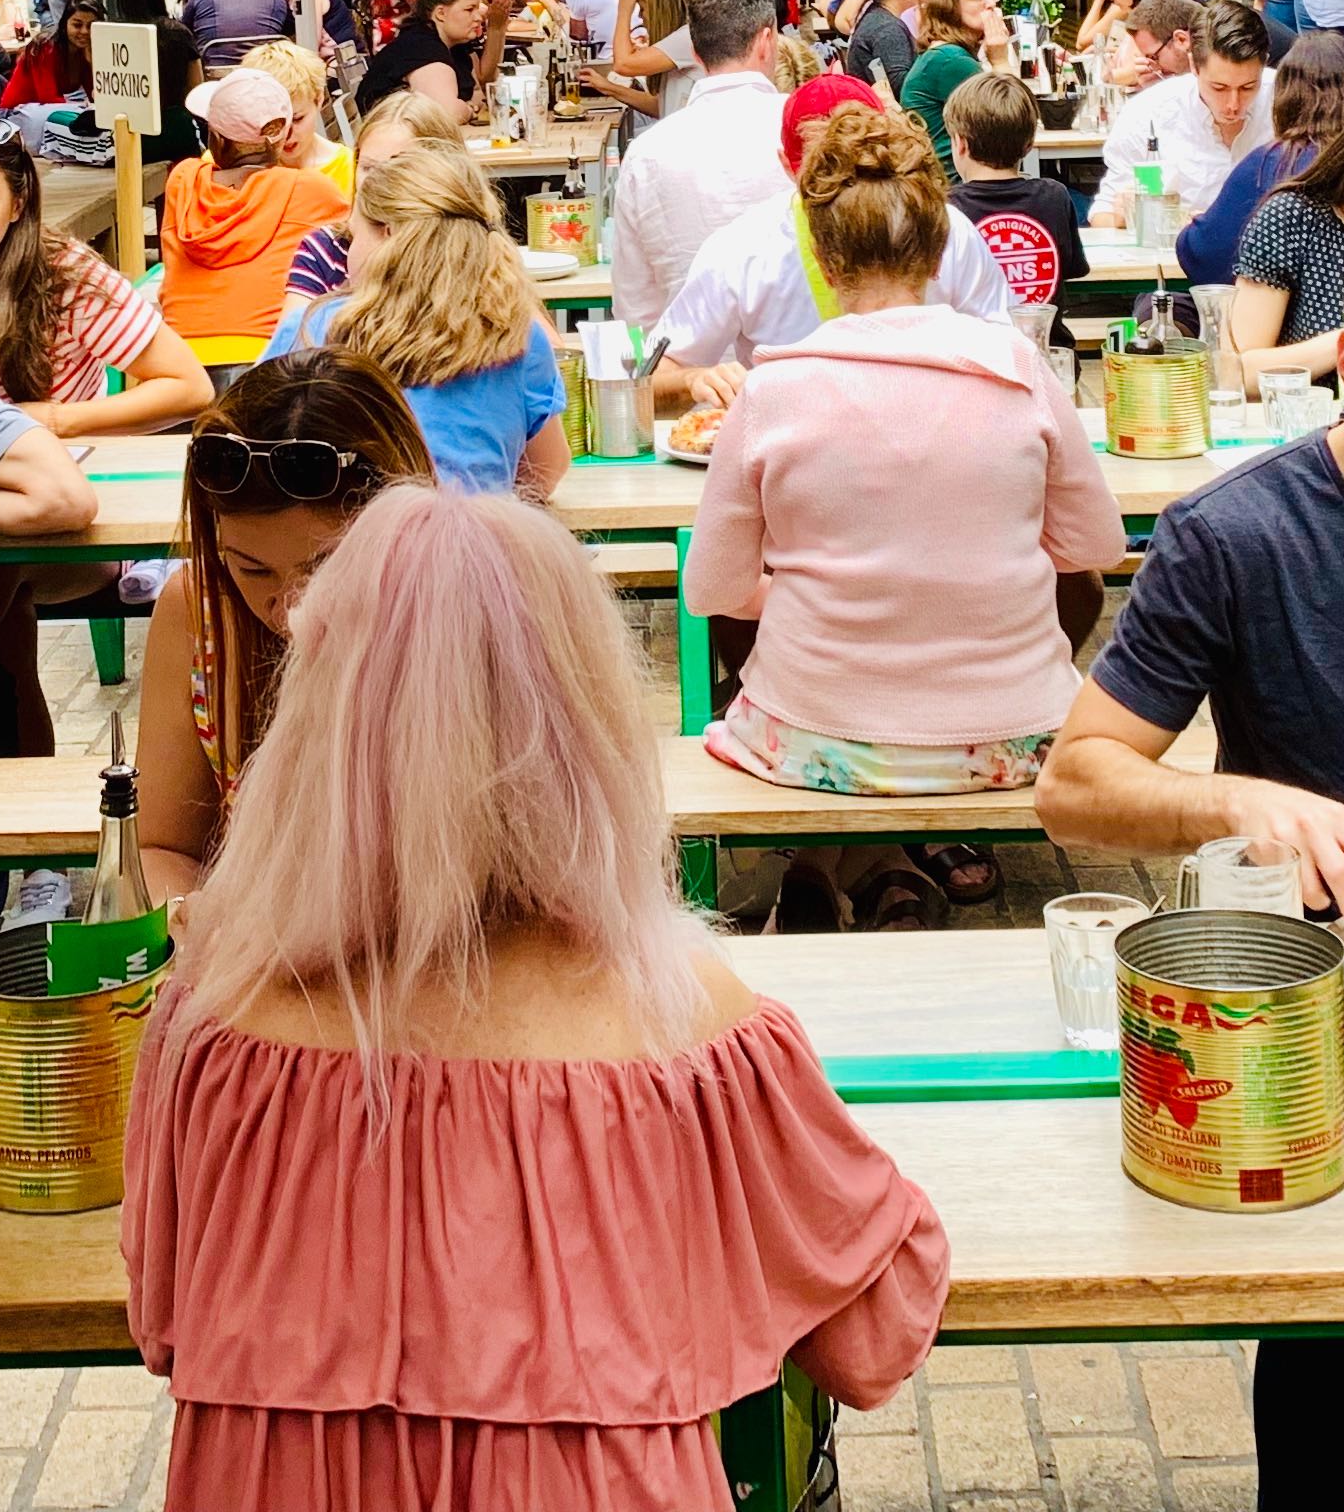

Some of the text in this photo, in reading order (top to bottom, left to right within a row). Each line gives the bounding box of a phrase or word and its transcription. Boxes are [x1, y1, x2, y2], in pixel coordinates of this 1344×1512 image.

[112, 43, 129, 67] NO
[95, 70, 150, 98] SMOKING
[545, 203, 586, 213] REGA
[990, 221, 1041, 243] ORIGINAL
[1130, 984, 1215, 1033] EGA
[1171, 1128, 1222, 1148] ITALIANI
[37, 1145, 92, 1163] PELADOS
[1161, 1151, 1223, 1176] TOMATOES
